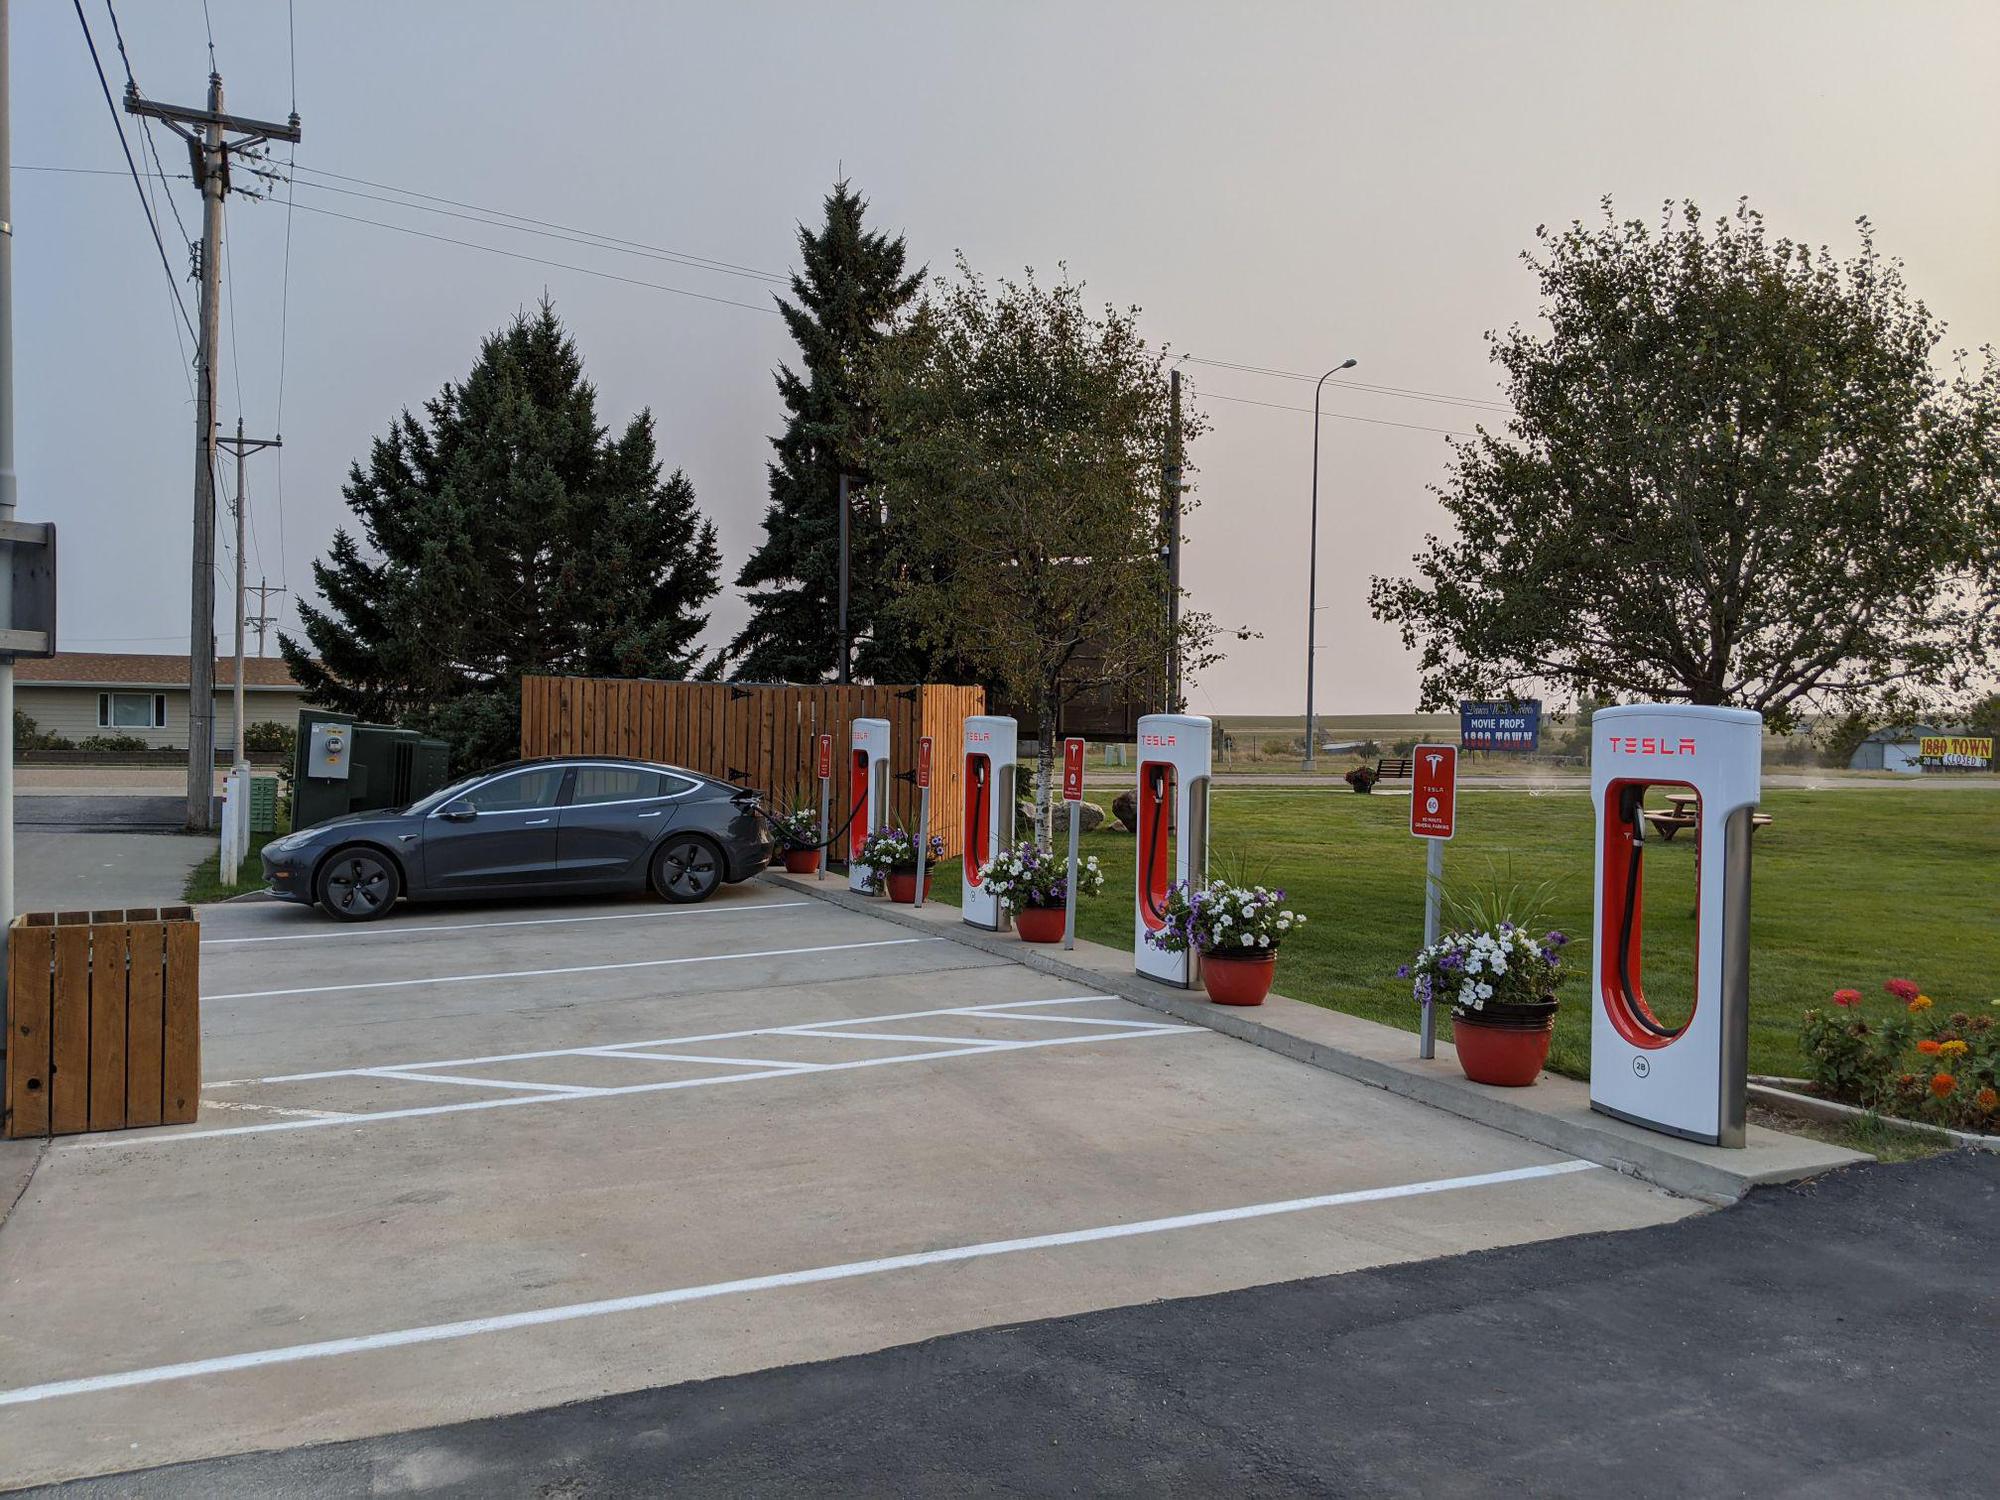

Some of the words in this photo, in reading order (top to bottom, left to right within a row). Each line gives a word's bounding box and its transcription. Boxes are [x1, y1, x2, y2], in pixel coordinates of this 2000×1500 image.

[1471, 719, 1496, 728] MOVIE
[1499, 719, 1525, 728] PROPS
[1141, 736, 1176, 746] TESLA
[1609, 737, 1695, 755] TESLA
[1921, 739, 1947, 755] 1880
[1951, 739, 1990, 757] TOWN
[1636, 1062, 1646, 1071] 2B
